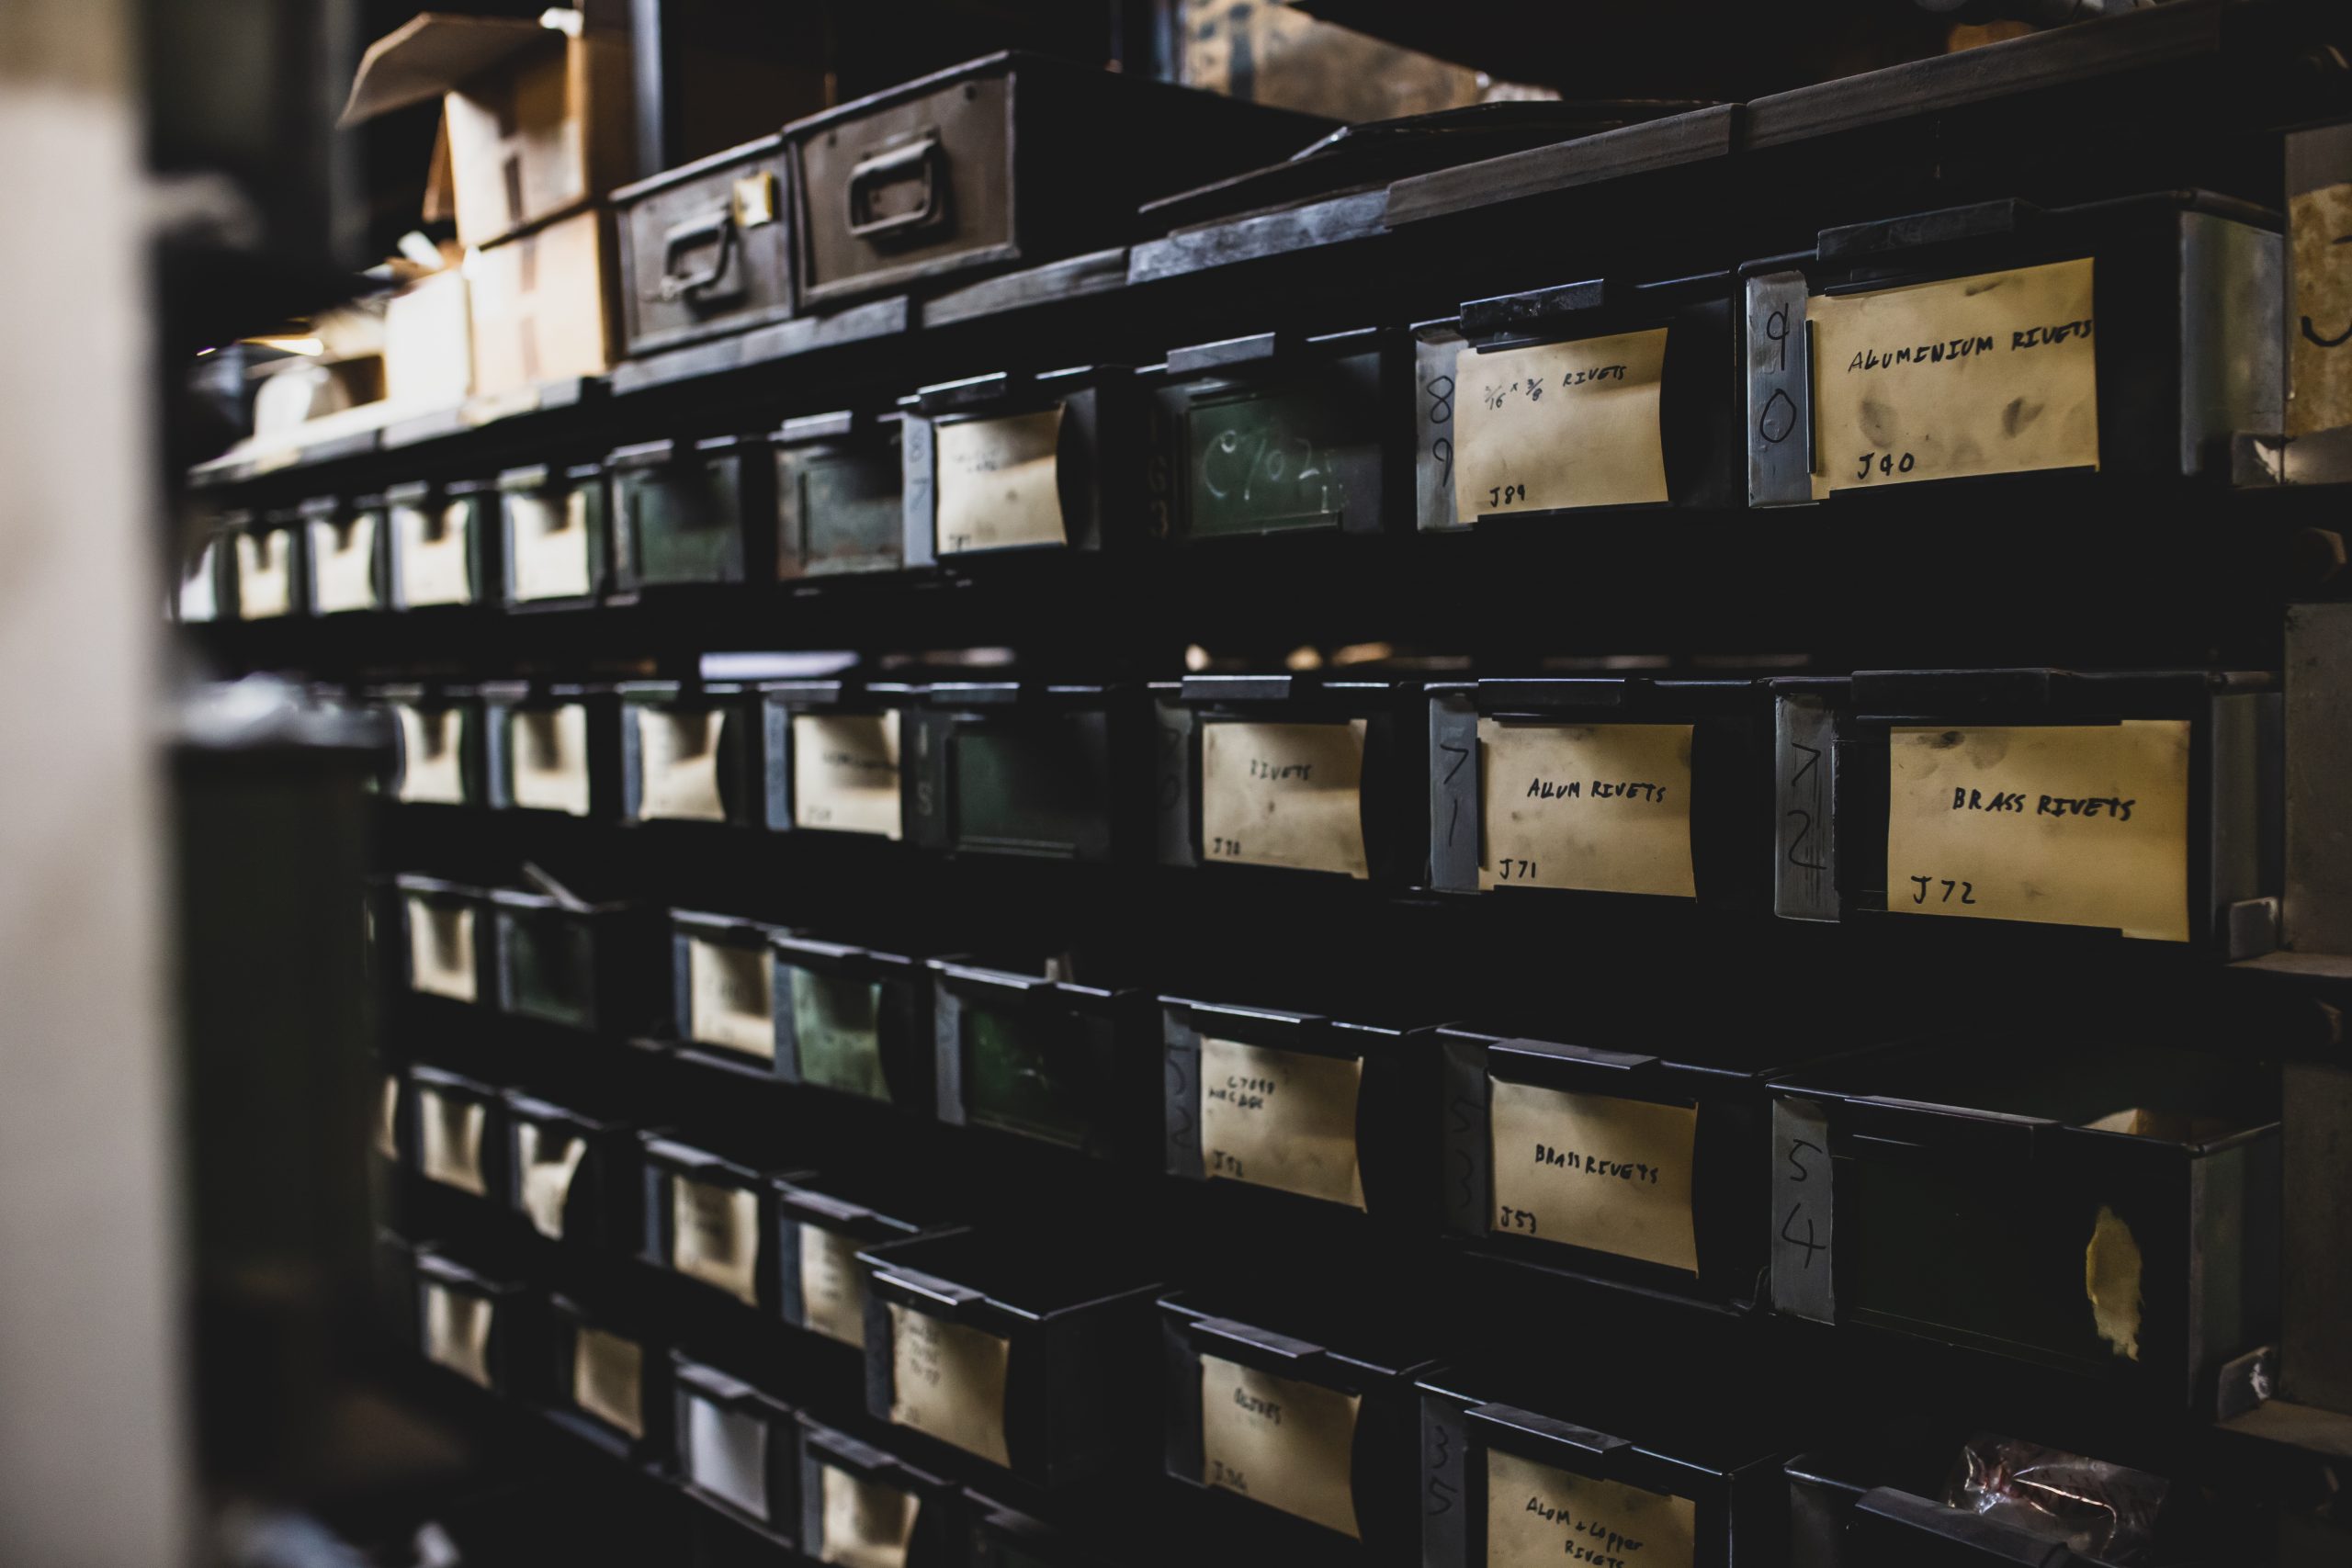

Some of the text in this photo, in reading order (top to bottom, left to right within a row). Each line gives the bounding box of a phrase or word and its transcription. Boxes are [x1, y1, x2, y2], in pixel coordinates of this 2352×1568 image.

[2011, 319, 2094, 350] RIVETS
[1563, 365, 1628, 387] RIVETS
[1857, 452, 1916, 479] J90
[1489, 483, 1526, 508] J89
[1590, 780, 1668, 804] RIVETS
[1952, 786, 2137, 822] BRASS RIVETS
[1499, 859, 1537, 880] J71
[1910, 874, 1976, 905] J72
[1585, 1156, 1659, 1185] RIVETS
